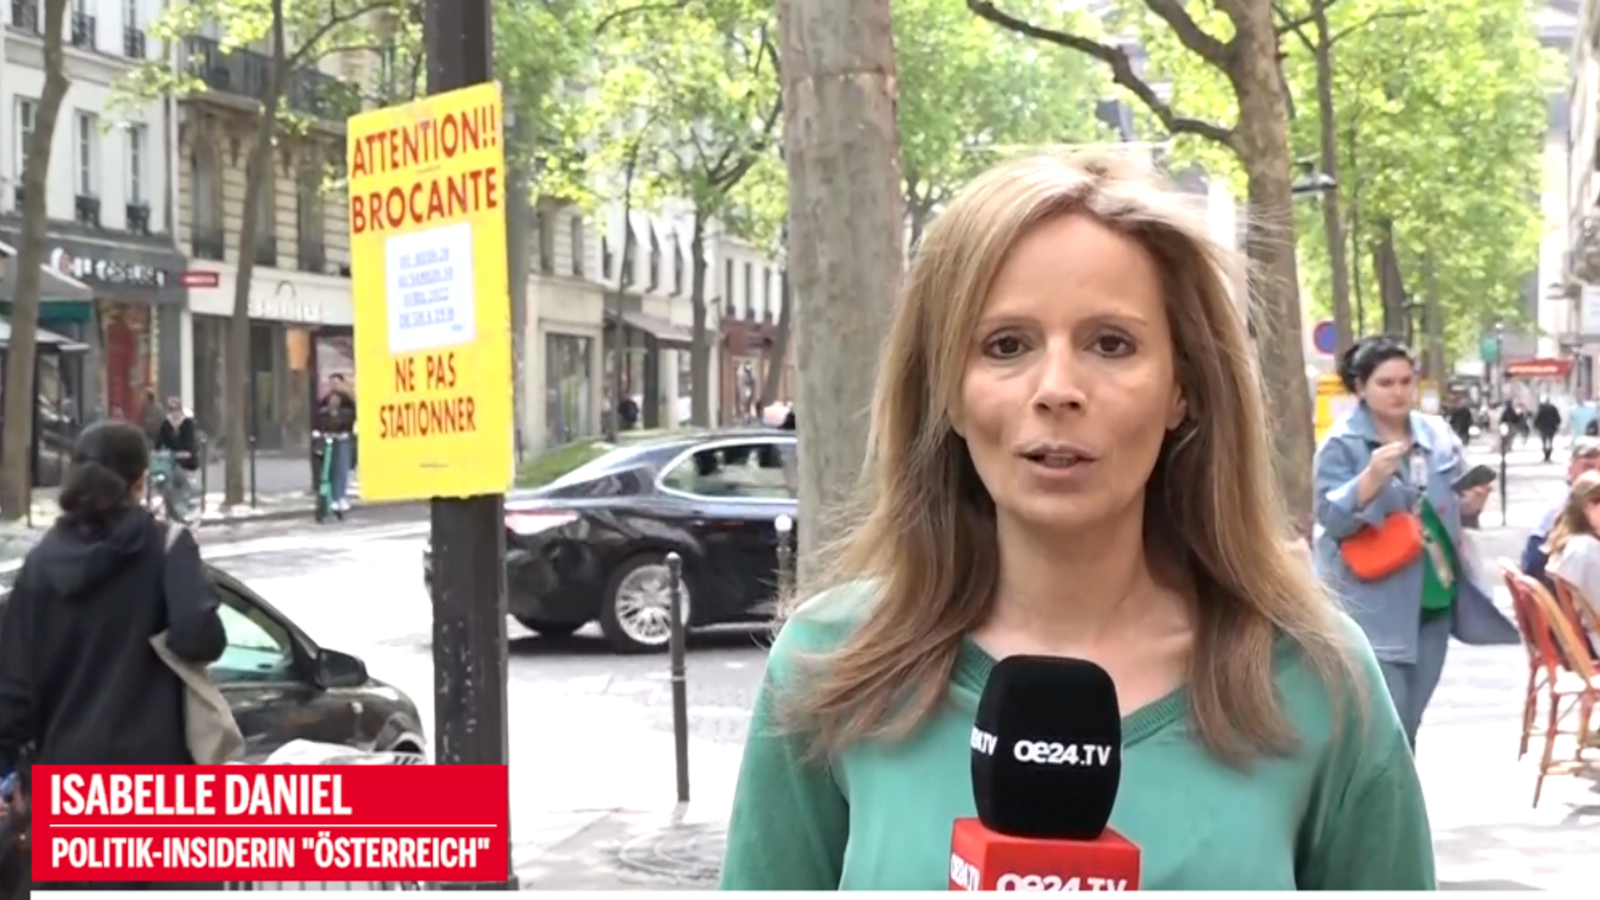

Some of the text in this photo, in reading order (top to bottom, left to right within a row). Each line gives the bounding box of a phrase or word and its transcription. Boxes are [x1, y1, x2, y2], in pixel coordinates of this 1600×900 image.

[351, 103, 496, 179] ATTENTION!!
[351, 166, 498, 235] BROCANTE
[395, 352, 457, 393] NE PAS
[379, 396, 476, 439] STATIONNER
